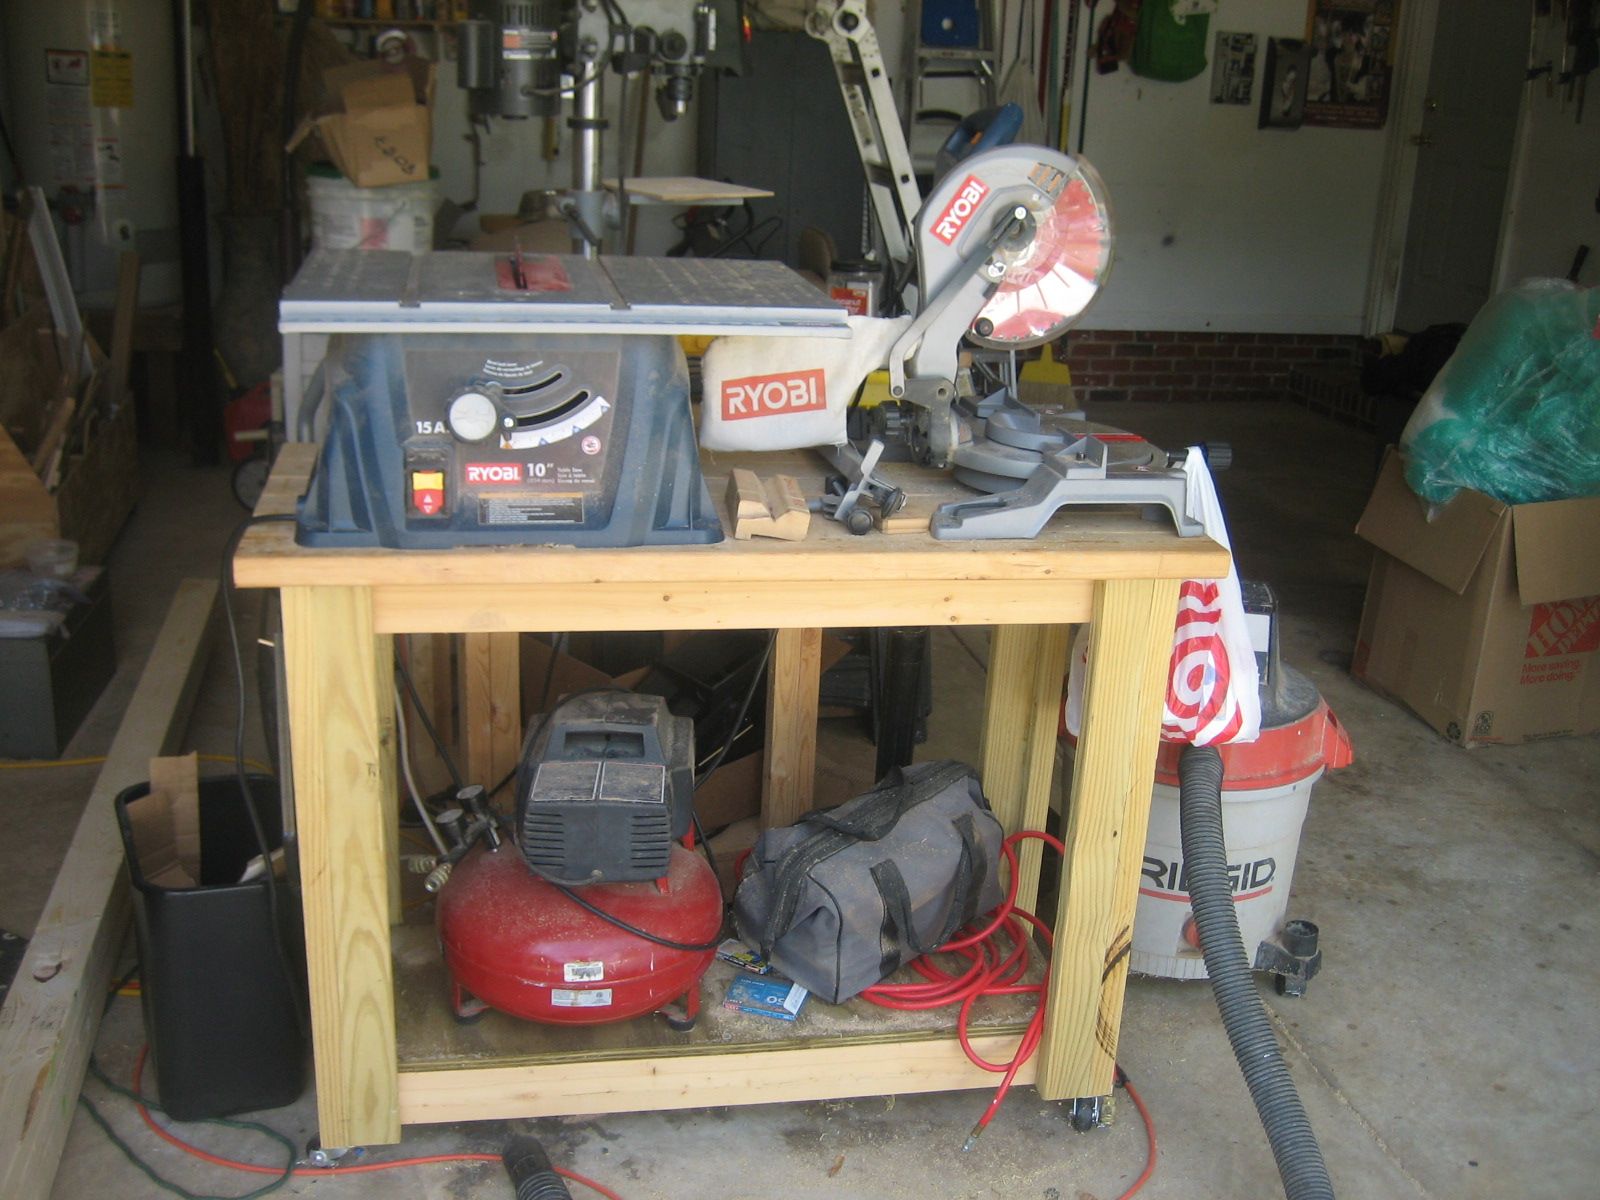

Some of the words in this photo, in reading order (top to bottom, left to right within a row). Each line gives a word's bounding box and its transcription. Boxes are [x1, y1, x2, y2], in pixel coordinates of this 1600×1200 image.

[935, 180, 986, 240] RYOBI
[725, 376, 817, 415] RYOBI
[466, 465, 520, 481] RYOBI
